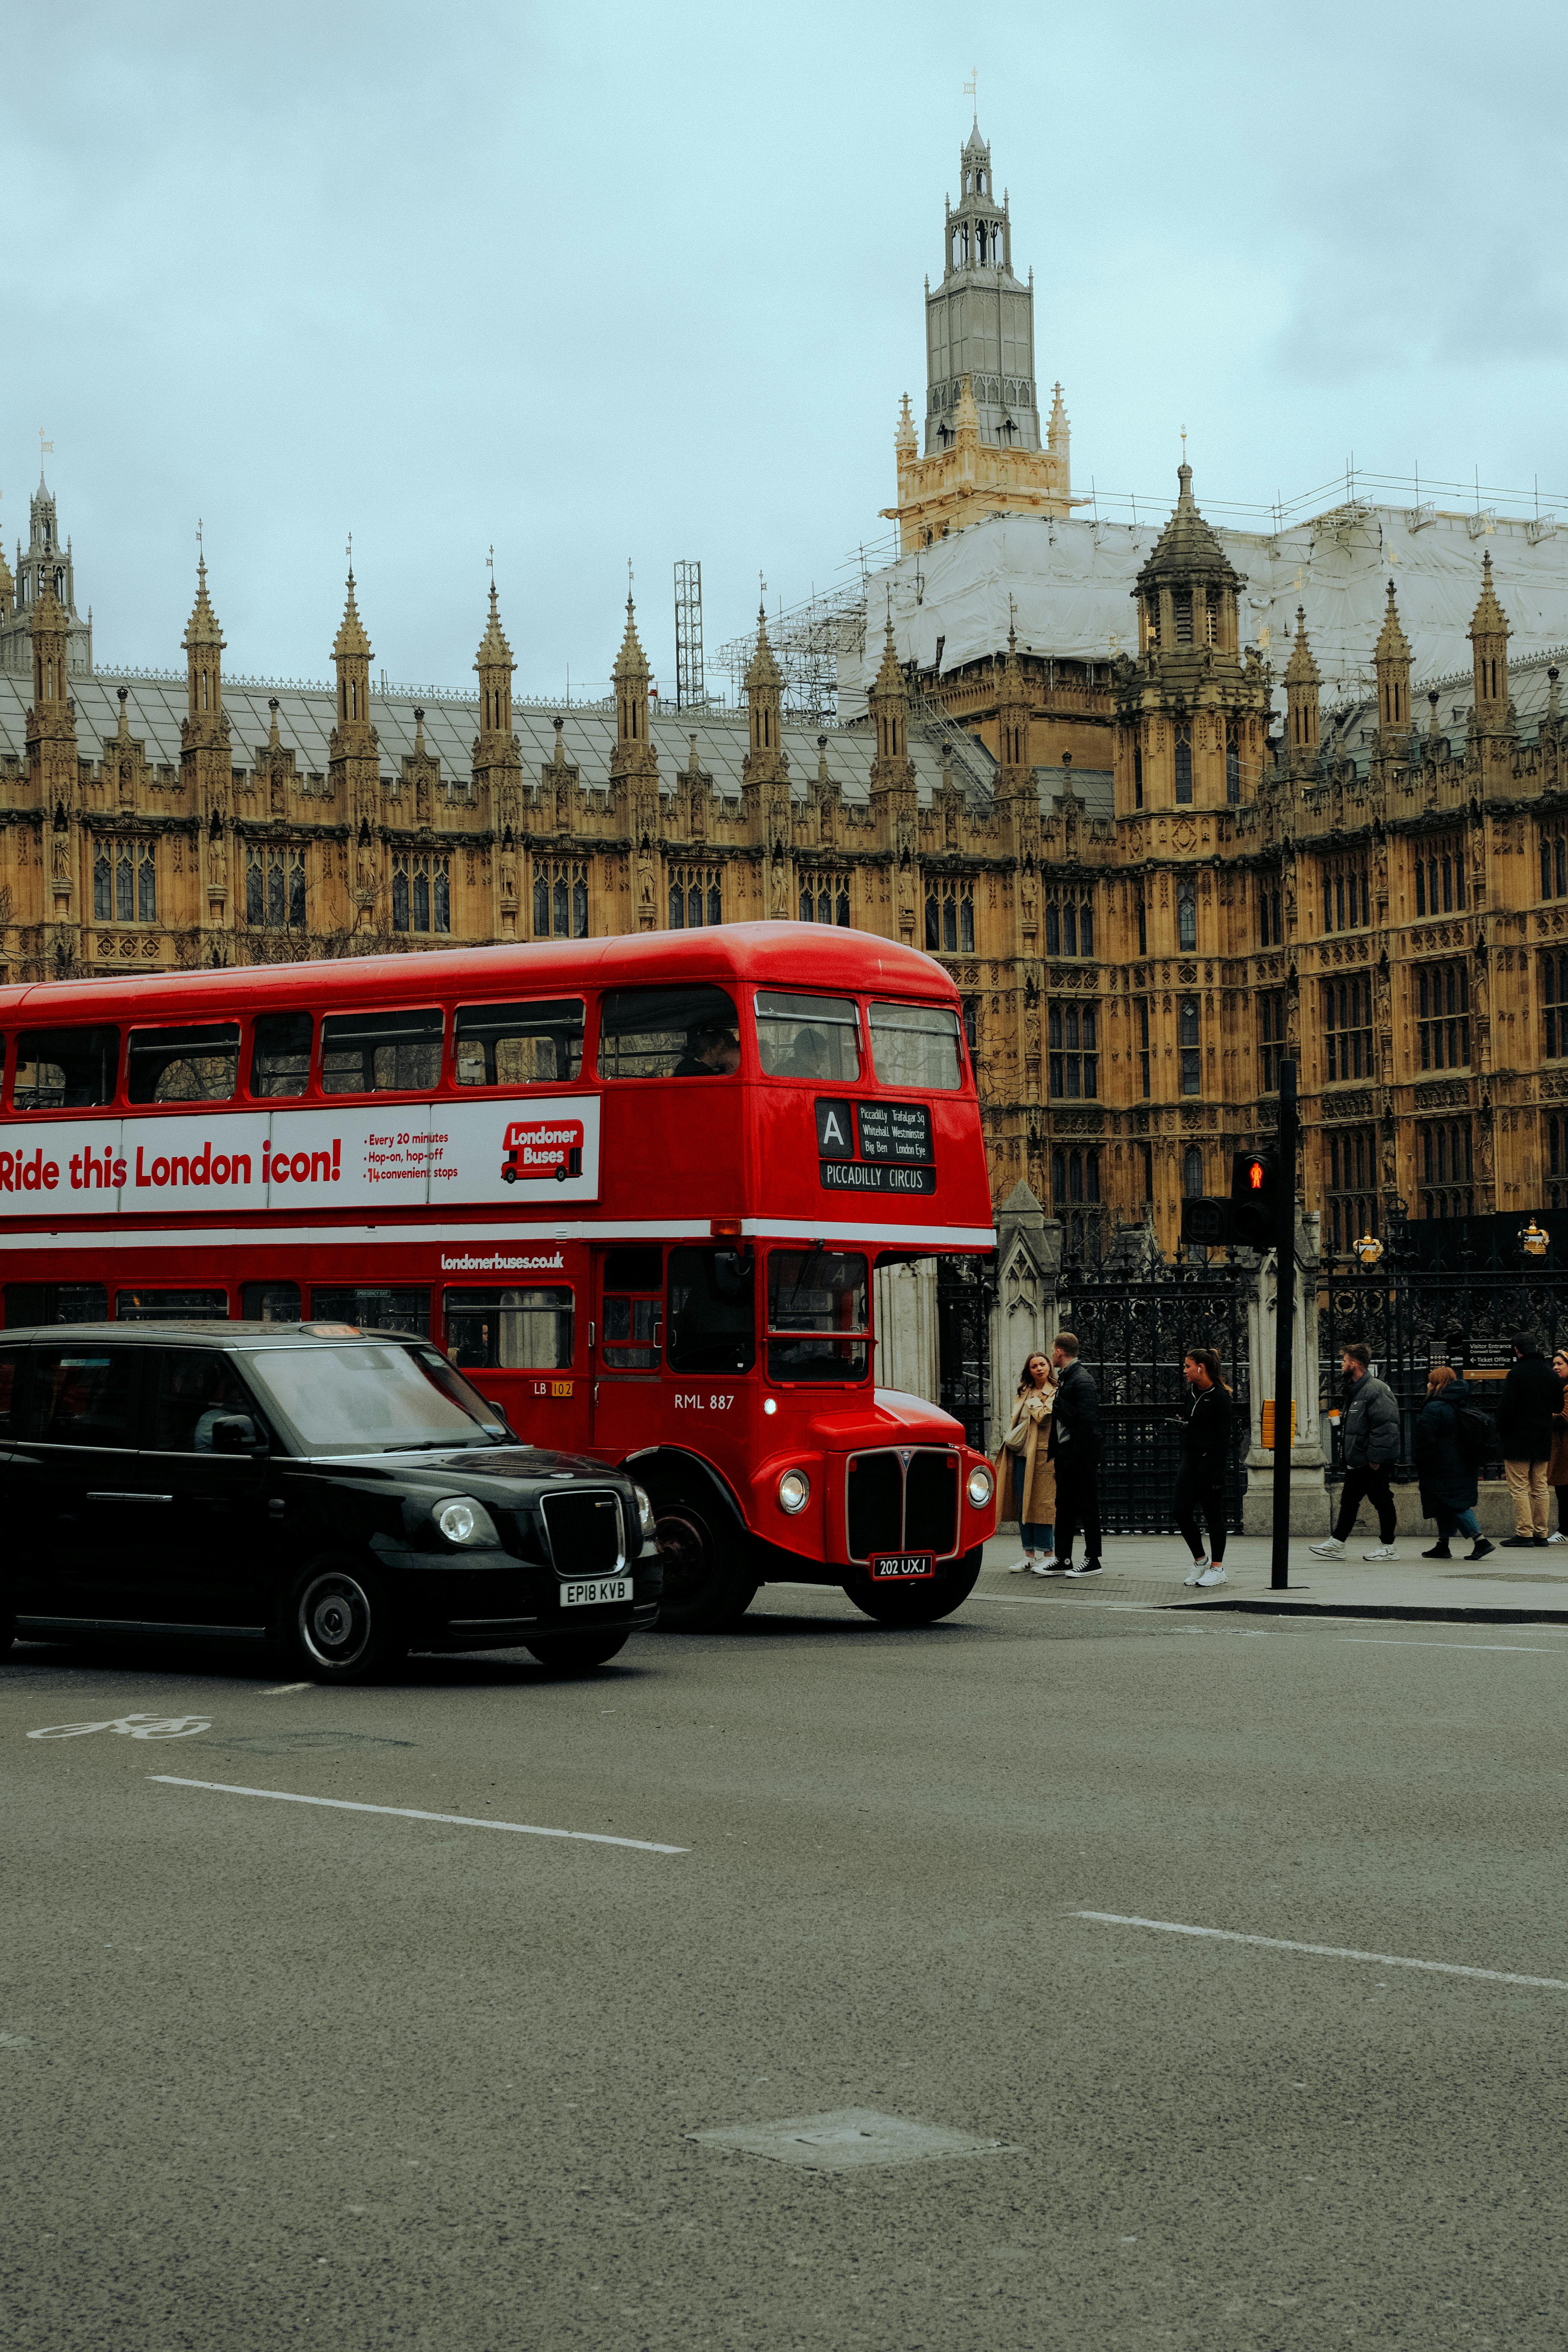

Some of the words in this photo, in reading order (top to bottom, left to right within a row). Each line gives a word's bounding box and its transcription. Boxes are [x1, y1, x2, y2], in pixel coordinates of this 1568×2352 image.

[861, 1107, 887, 1123] Piccadilly
[892, 1110, 916, 1125] Trafalgar
[917, 1112, 925, 1126] Sq
[511, 1126, 577, 1145] Londoner
[824, 1112, 844, 1145] A
[862, 1124, 890, 1137] Whitehall
[891, 1126, 925, 1139] Westminster
[369, 1134, 394, 1148] Every
[397, 1133, 410, 1144] 20
[412, 1133, 448, 1143] minutes
[369, 1152, 403, 1165] Hop-on,
[406, 1148, 443, 1164] hop-off
[524, 1147, 564, 1164] Buses
[865, 1141, 874, 1154] Big
[876, 1141, 887, 1153] Ben
[896, 1142, 914, 1155] London
[915, 1144, 925, 1158] Eye
[0, 1148, 59, 1191] Ride
[69, 1146, 127, 1188] this
[136, 1142, 251, 1187] London
[263, 1139, 341, 1183] icon!
[434, 1168, 458, 1177] stops
[827, 1165, 881, 1185] PICCADILLY
[890, 1169, 922, 1188] CIRCUS
[441, 1251, 564, 1269] londonerbuses.co.uk
[534, 1383, 546, 1394] LB
[554, 1383, 571, 1395] 102
[675, 1395, 704, 1409] RML
[710, 1395, 734, 1409] 887
[880, 1560, 898, 1574] 202
[902, 1559, 925, 1573] UXJ
[568, 1585, 596, 1603] EP18
[601, 1582, 625, 1599] KVB
